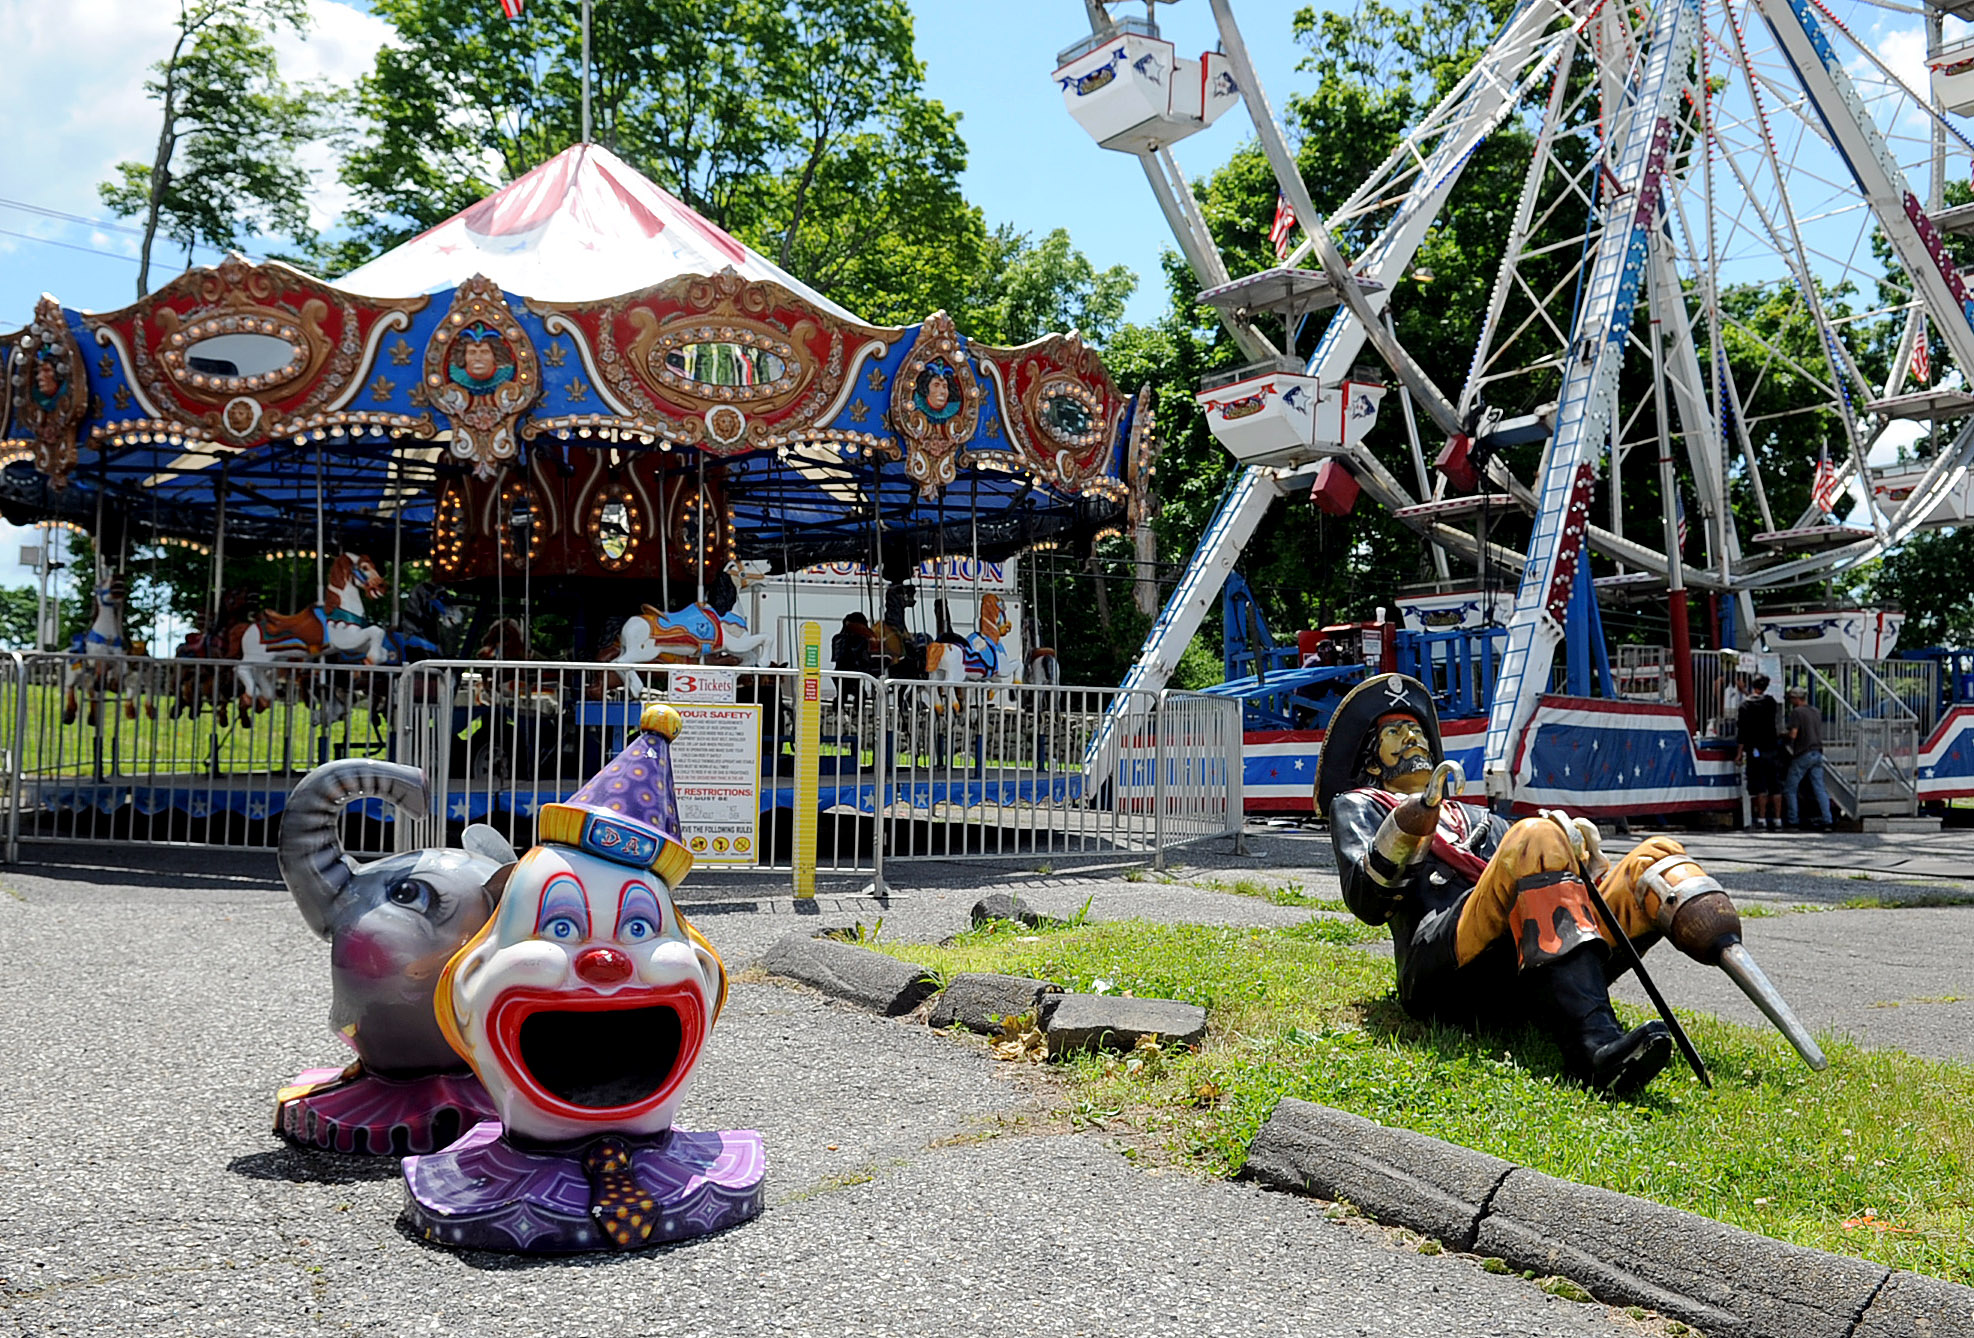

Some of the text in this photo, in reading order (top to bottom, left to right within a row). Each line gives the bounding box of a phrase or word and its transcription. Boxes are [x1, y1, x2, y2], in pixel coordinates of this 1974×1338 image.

[674, 676, 731, 692] 3 Tickets
[684, 788, 753, 796] RESTRICTIONS:
